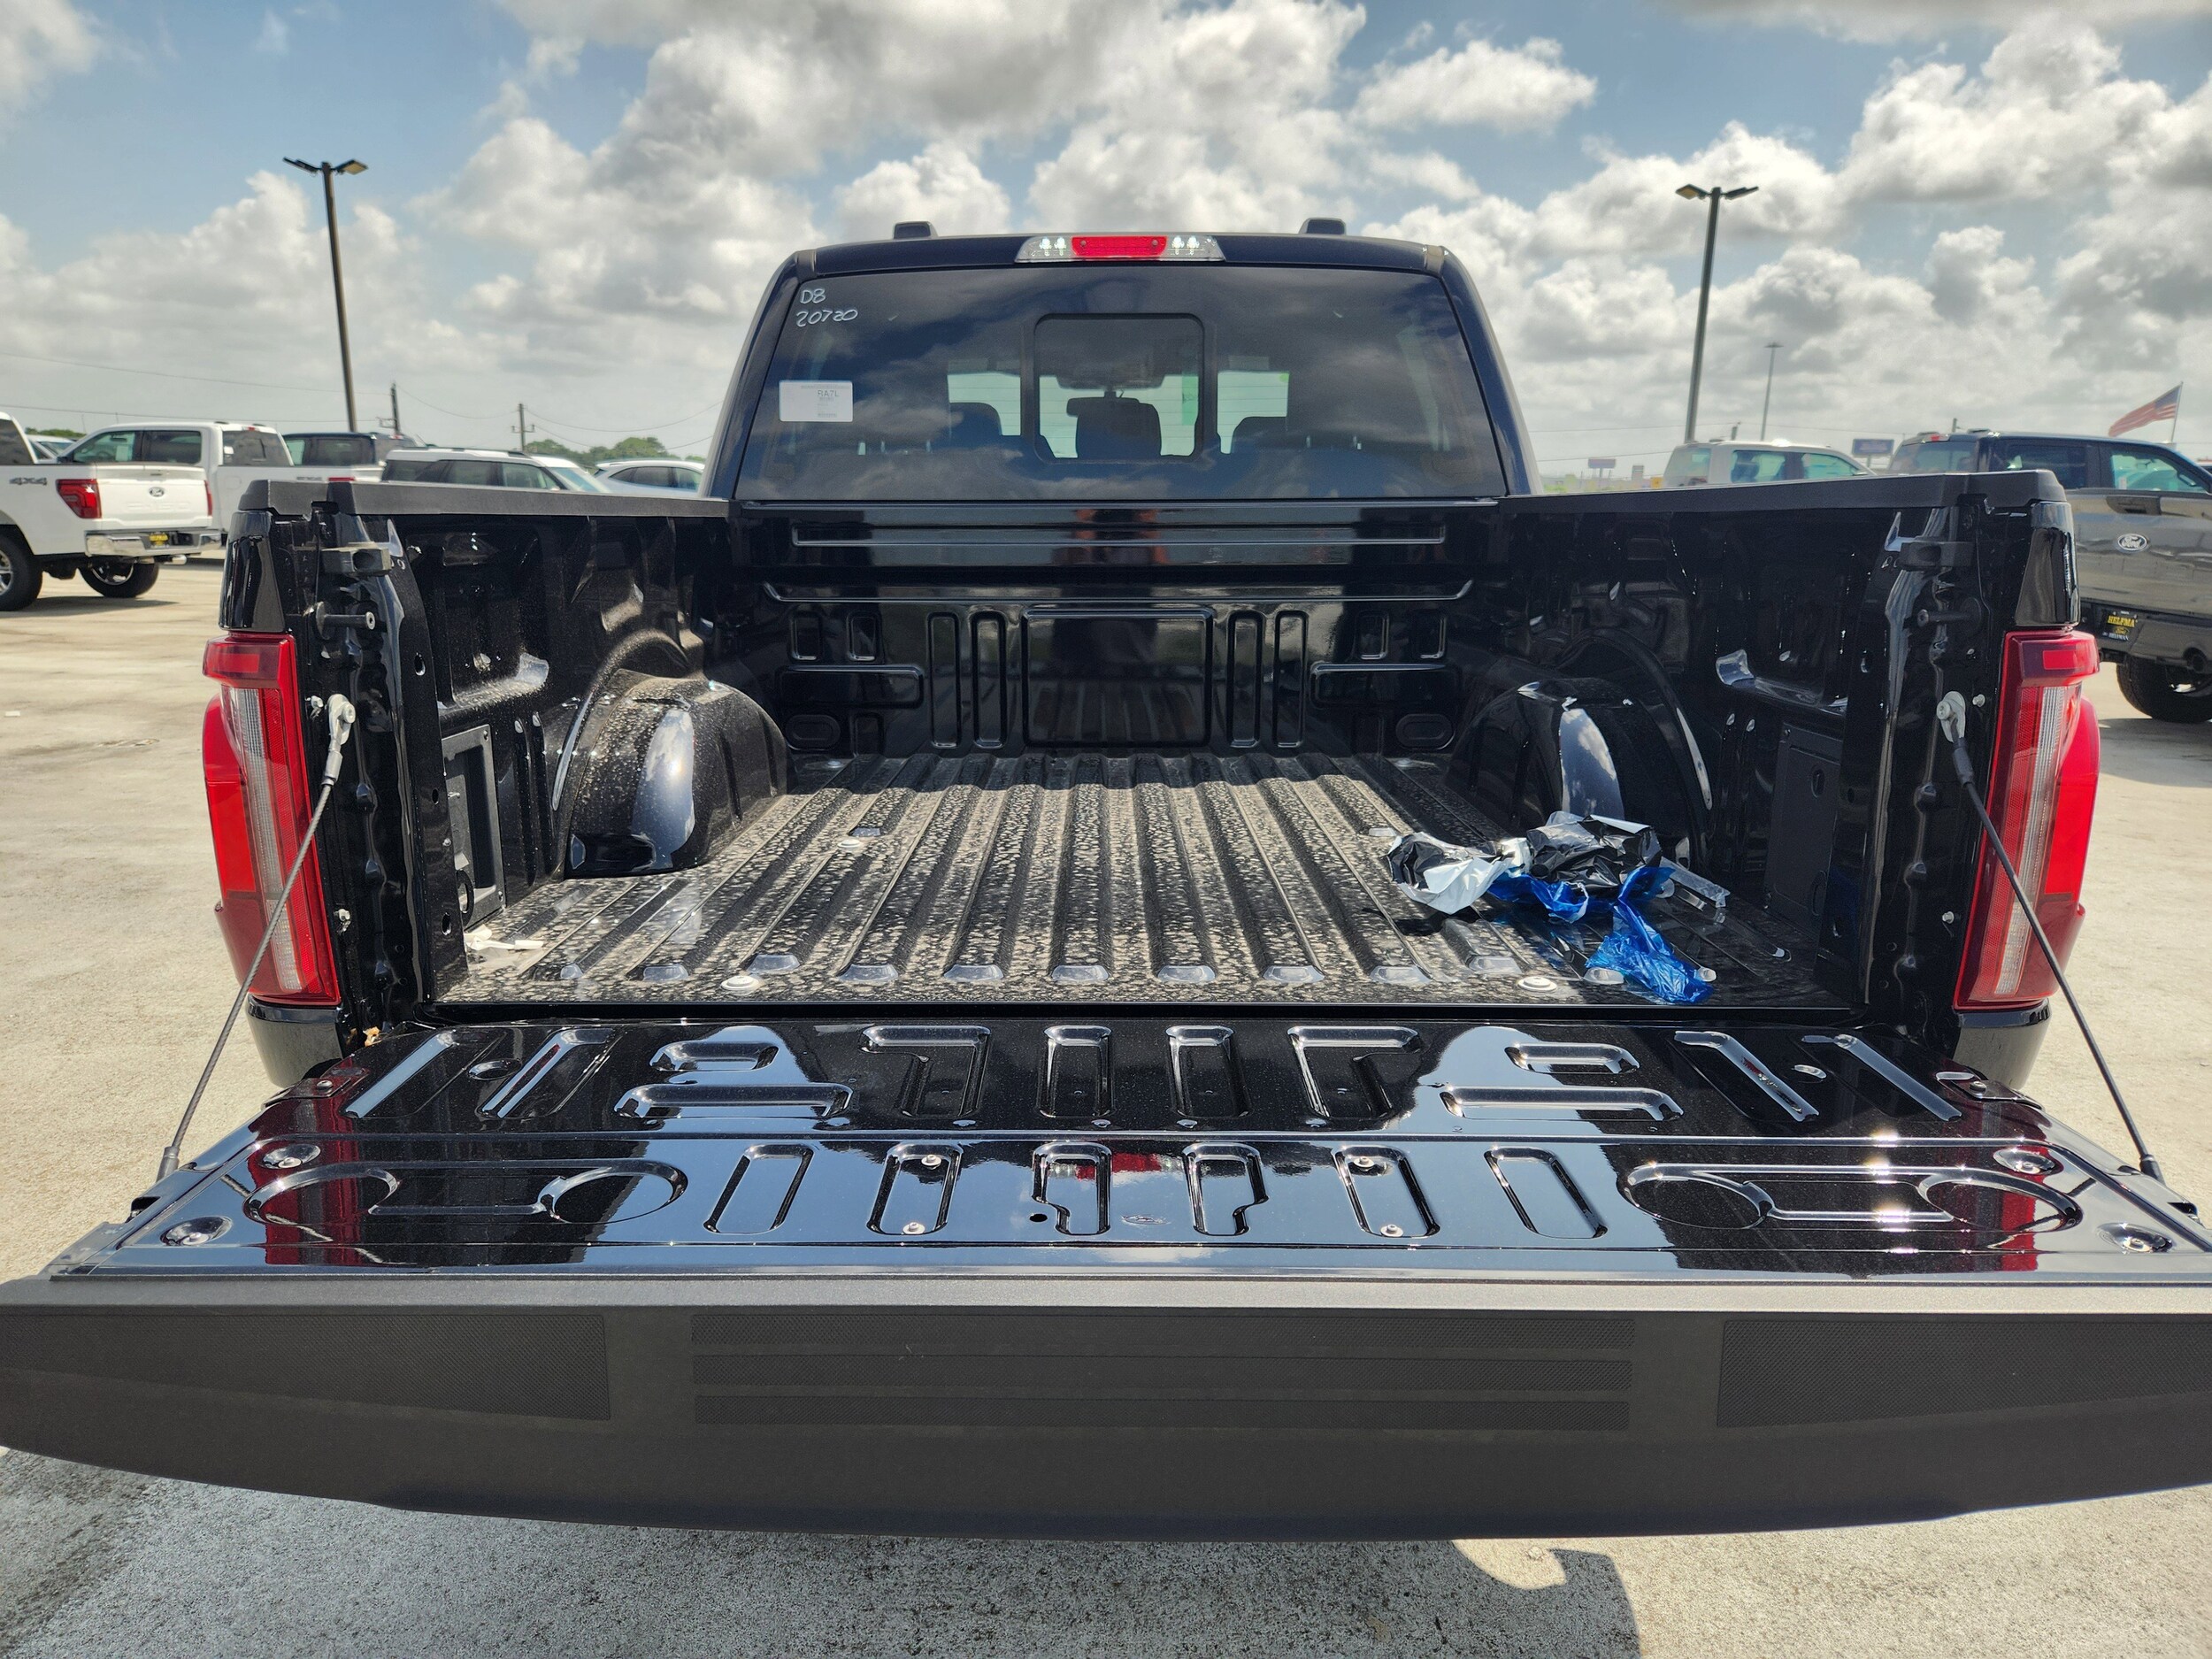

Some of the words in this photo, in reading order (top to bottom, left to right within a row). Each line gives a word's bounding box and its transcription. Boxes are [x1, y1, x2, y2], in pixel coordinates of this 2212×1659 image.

[800, 288, 826, 304] D8
[796, 309, 858, 327] 20720
[2120, 535, 2144, 549] Ford
